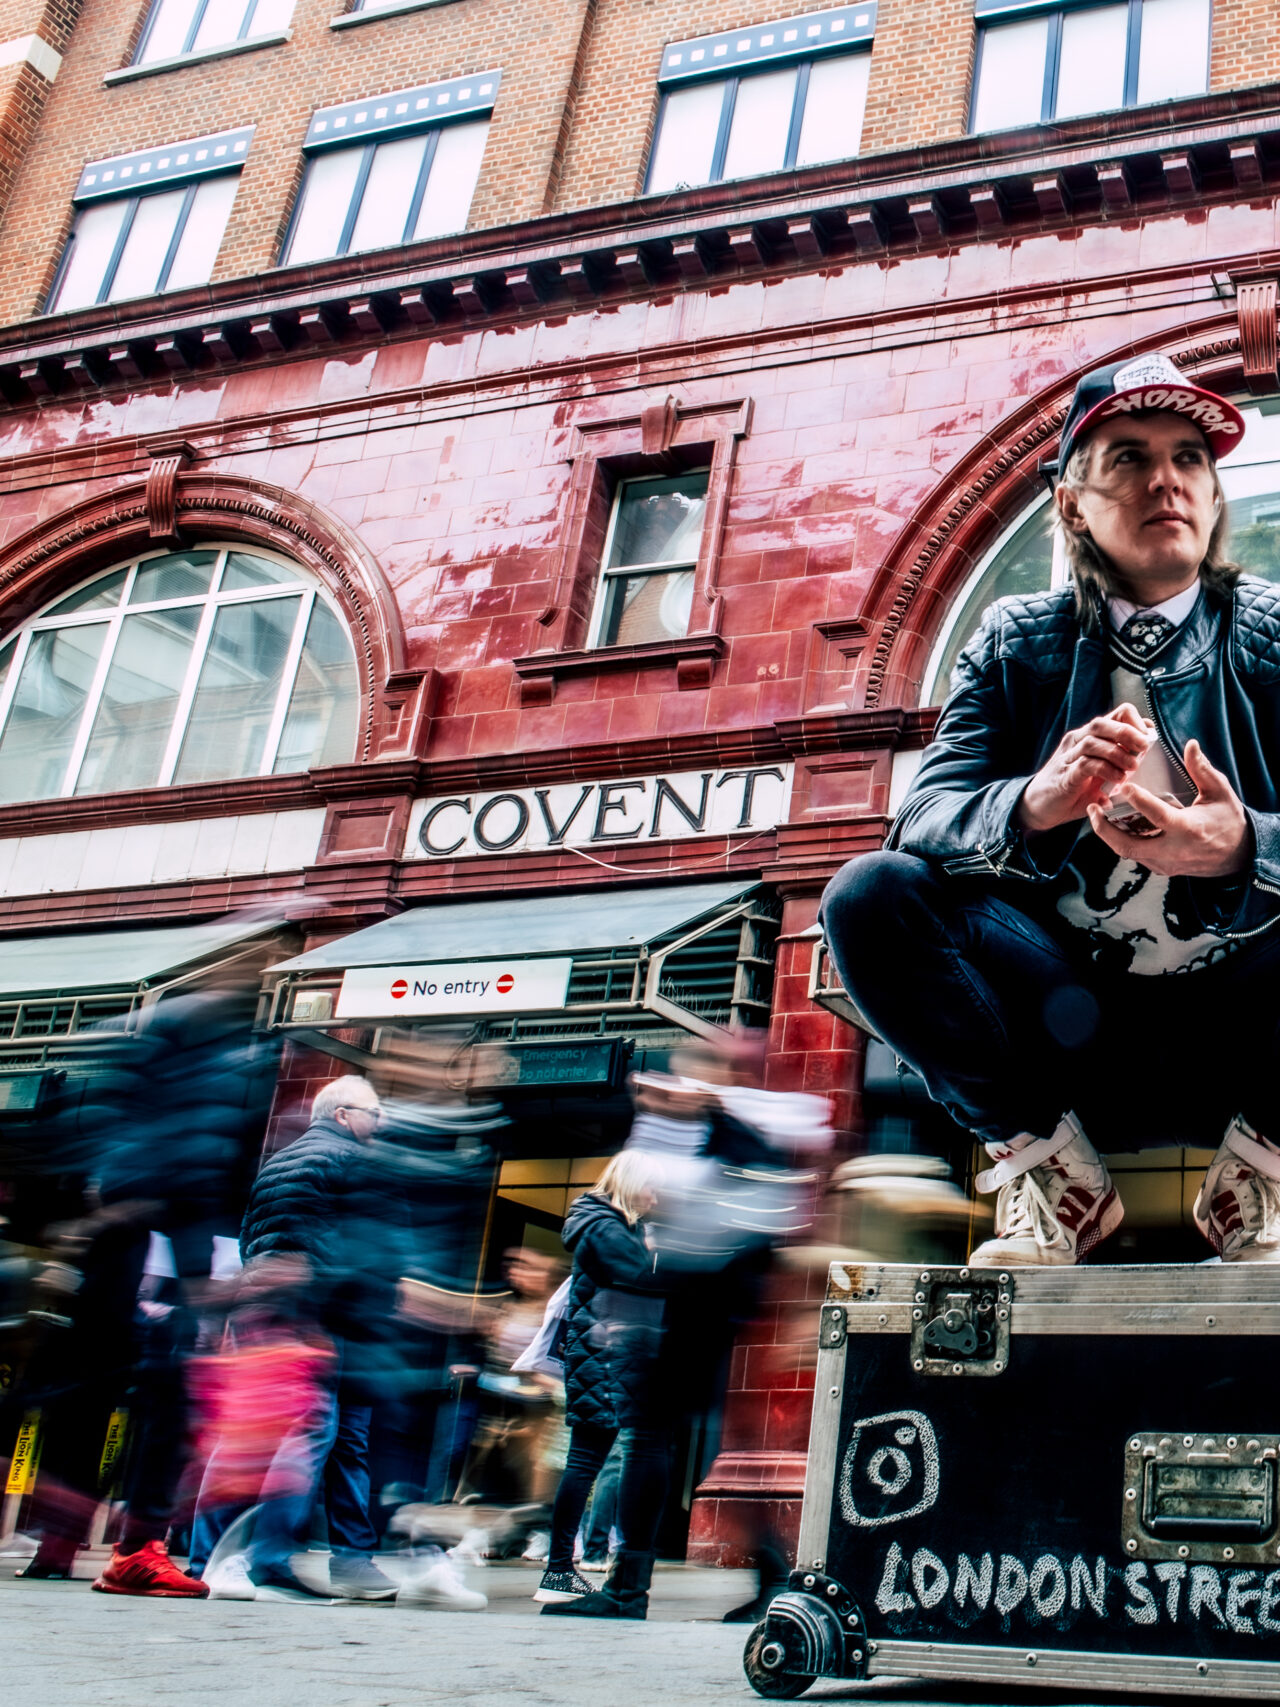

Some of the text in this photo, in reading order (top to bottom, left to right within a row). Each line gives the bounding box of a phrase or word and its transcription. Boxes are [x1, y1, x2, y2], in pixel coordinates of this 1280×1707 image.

[418, 767, 785, 856] COVENT
[413, 980, 490, 997] No entry
[523, 1048, 588, 1063] Emergency
[519, 1066, 587, 1080] Do not enter
[21, 1421, 31, 1436] THE
[109, 1423, 120, 1440] THE
[16, 1437, 31, 1458] LION
[104, 1440, 118, 1461] LION
[11, 1459, 25, 1482] KING
[874, 1541, 1107, 1618] LONDON
